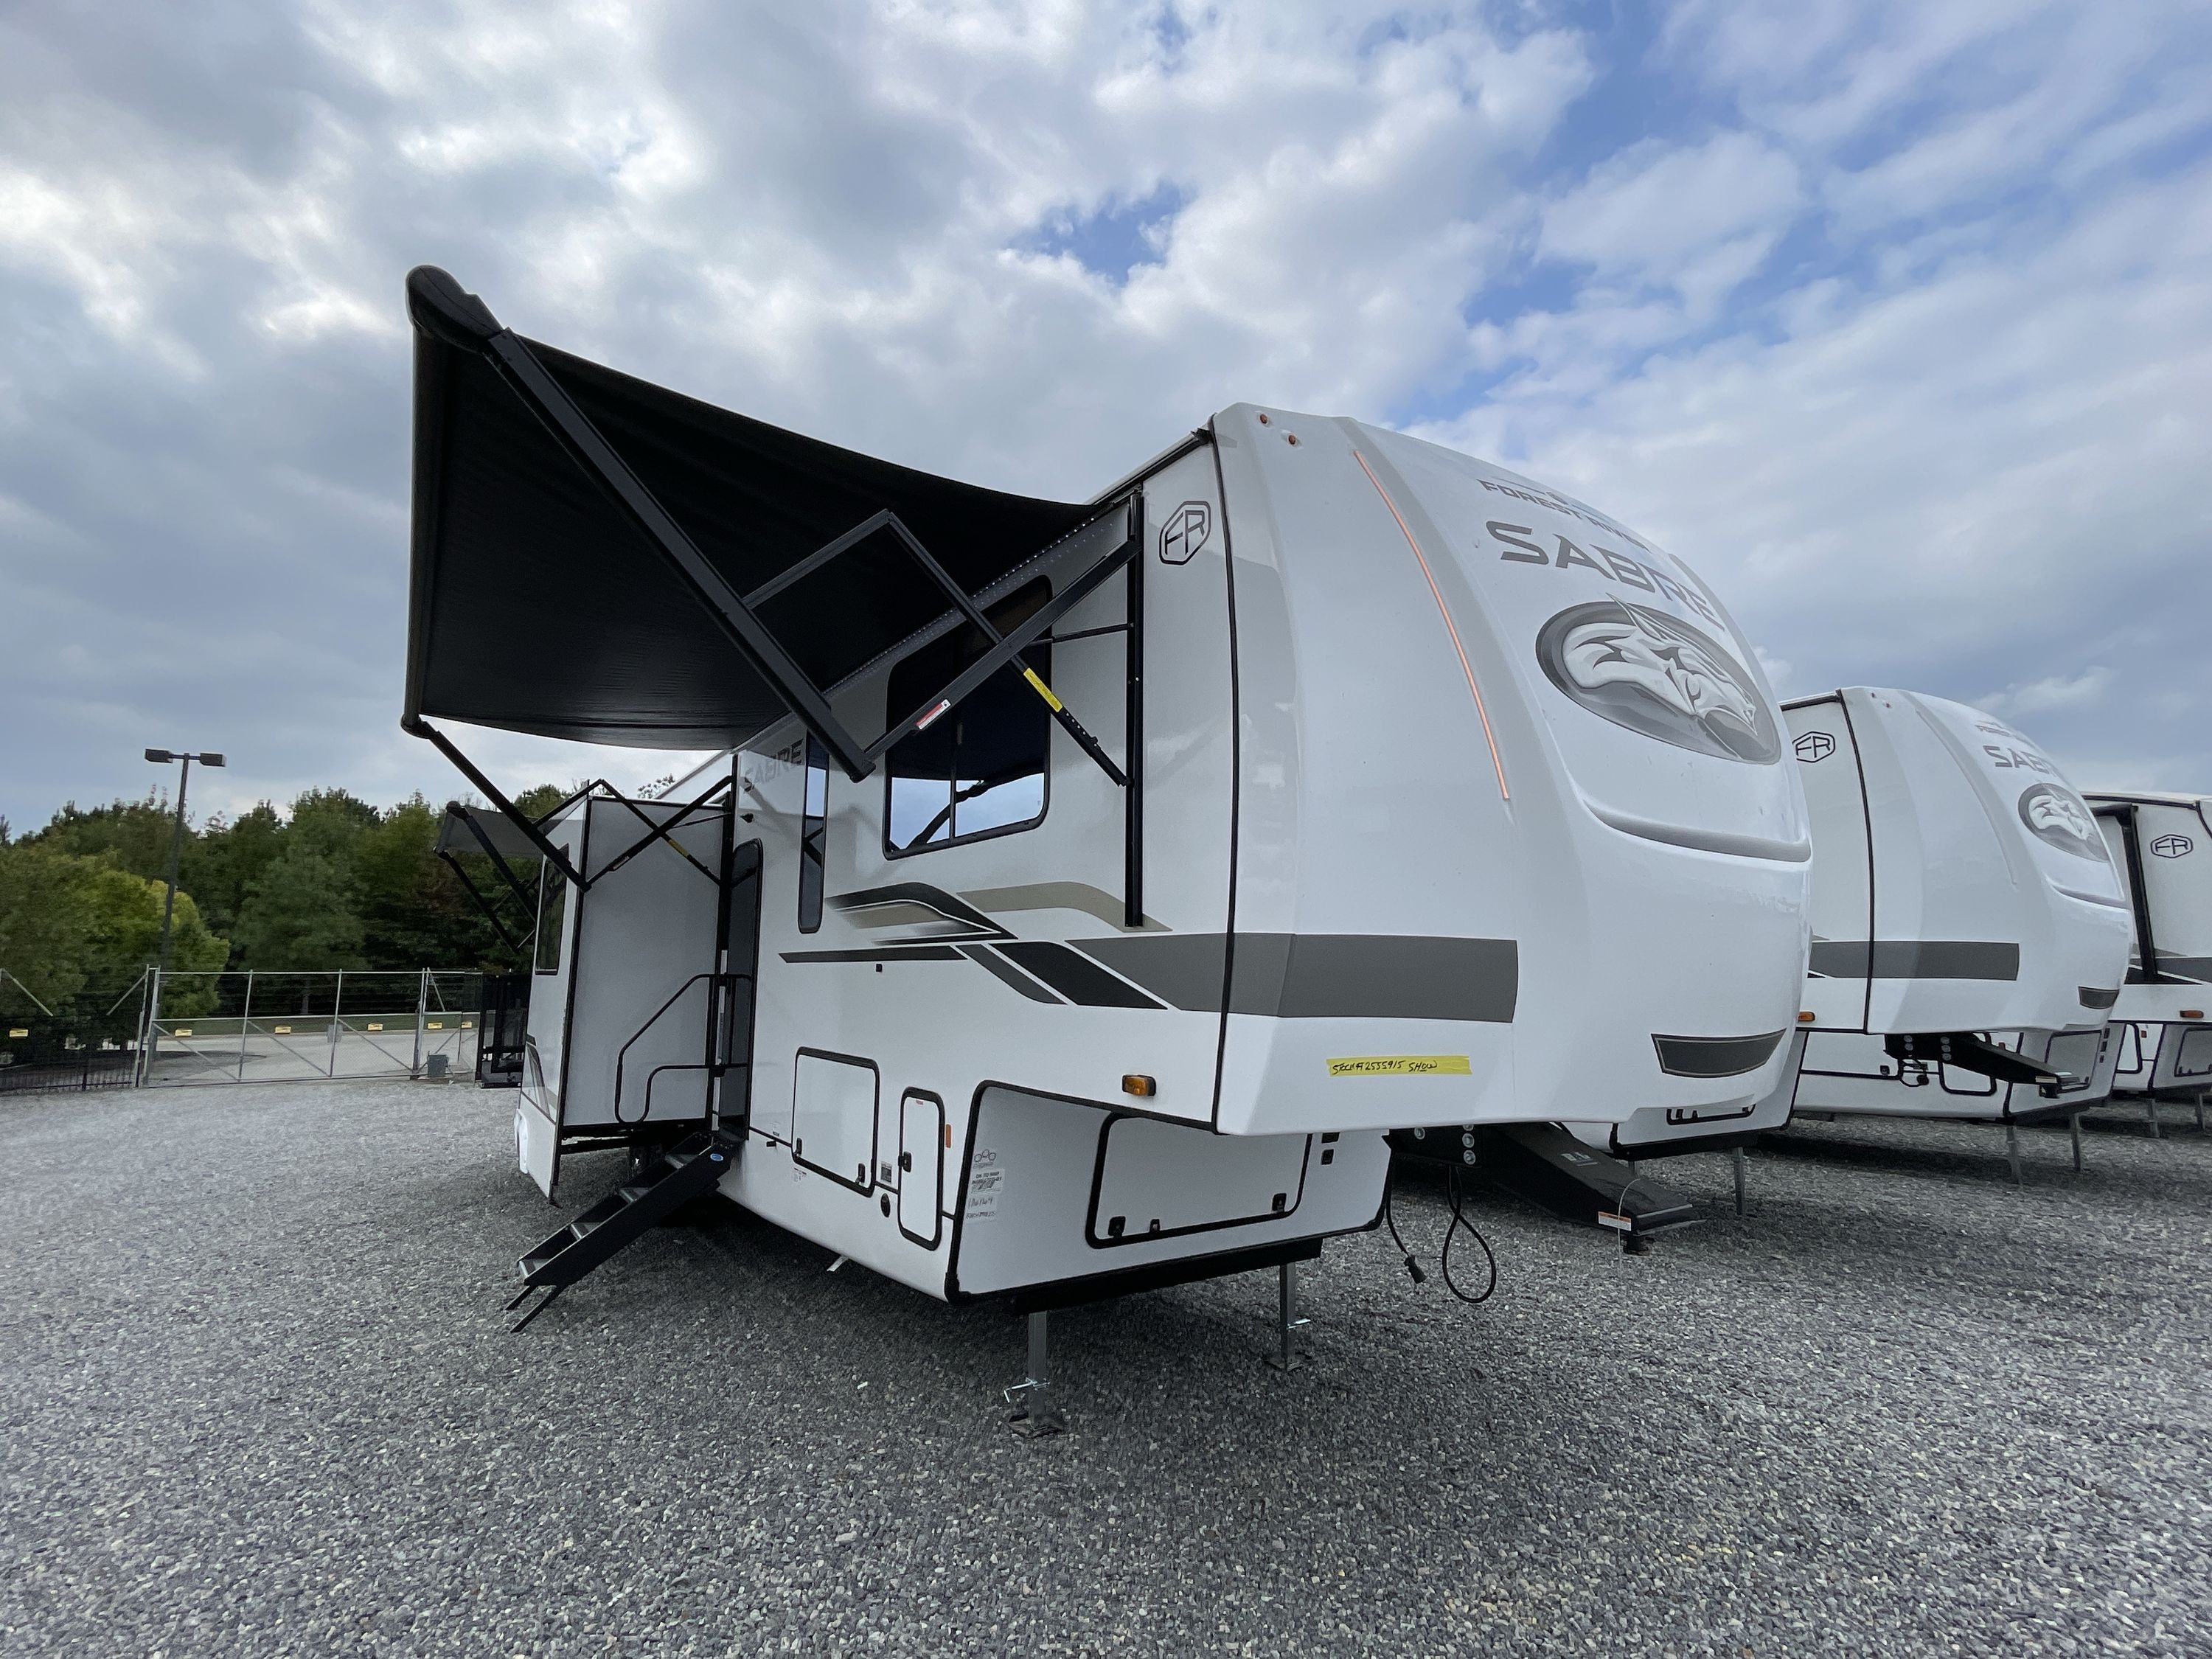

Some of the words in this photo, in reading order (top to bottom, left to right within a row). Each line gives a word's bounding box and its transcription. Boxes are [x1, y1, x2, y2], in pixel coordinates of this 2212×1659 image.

[1475, 479, 1583, 520] FOREST
[1485, 520, 1725, 632] SABRE
[1794, 735, 1832, 759] FR
